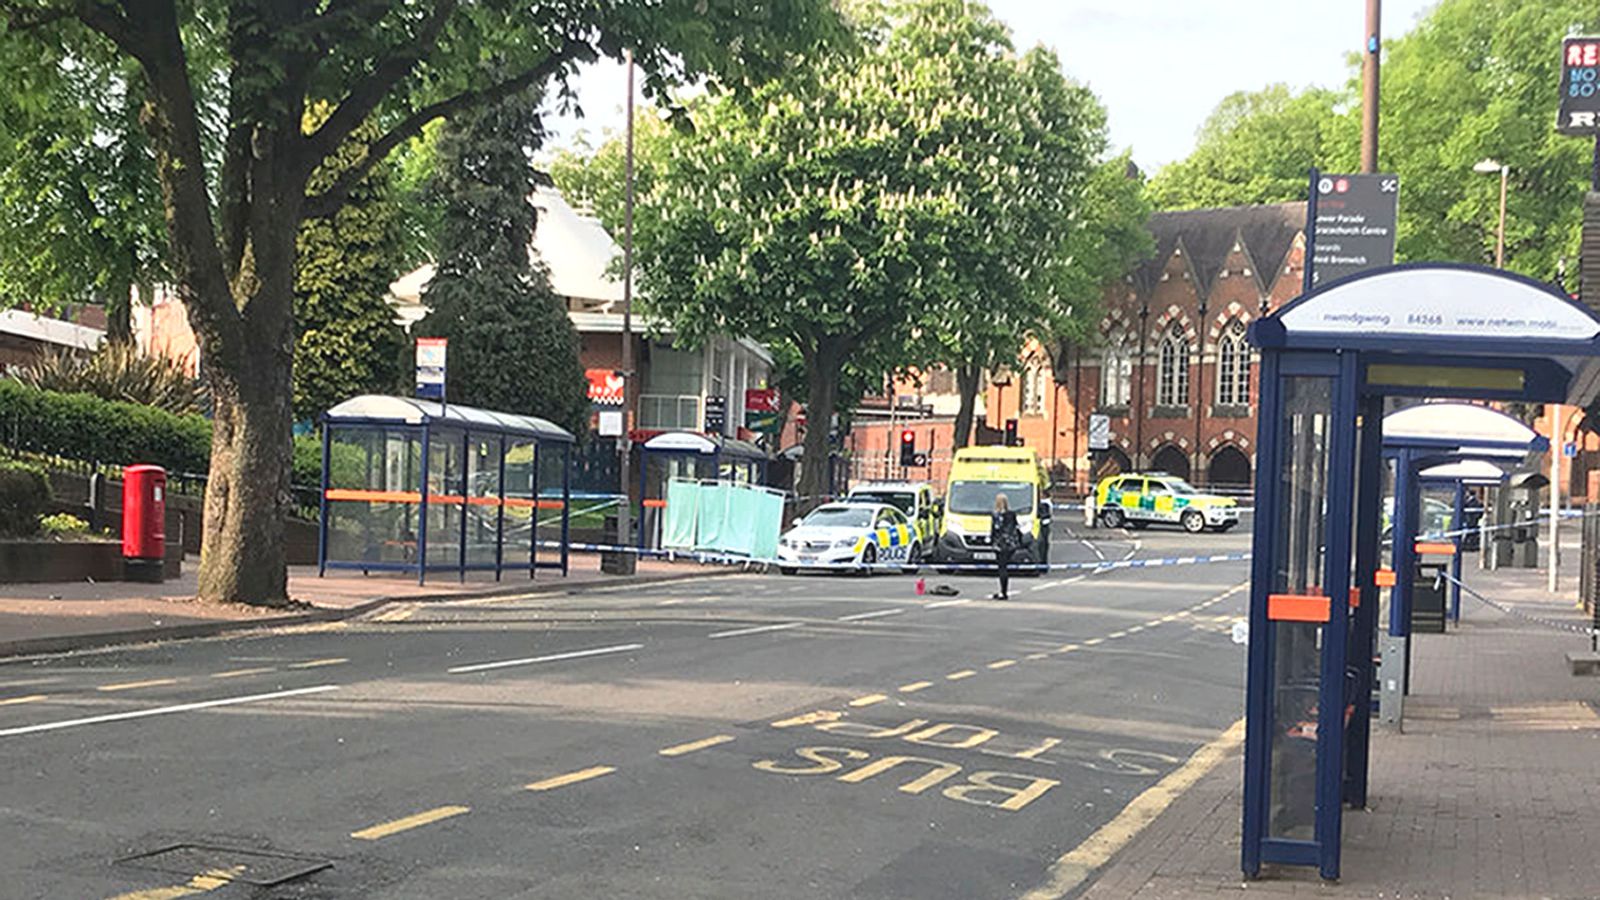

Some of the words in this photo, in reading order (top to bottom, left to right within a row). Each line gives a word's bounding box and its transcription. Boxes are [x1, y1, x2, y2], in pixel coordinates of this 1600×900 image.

[1567, 44, 1600, 66] RE
[1569, 112, 1600, 127] R
[1337, 214, 1365, 223] Parade
[1360, 225, 1388, 236] Centre
[878, 546, 908, 561] POLICE
[752, 746, 1061, 811] BUS
